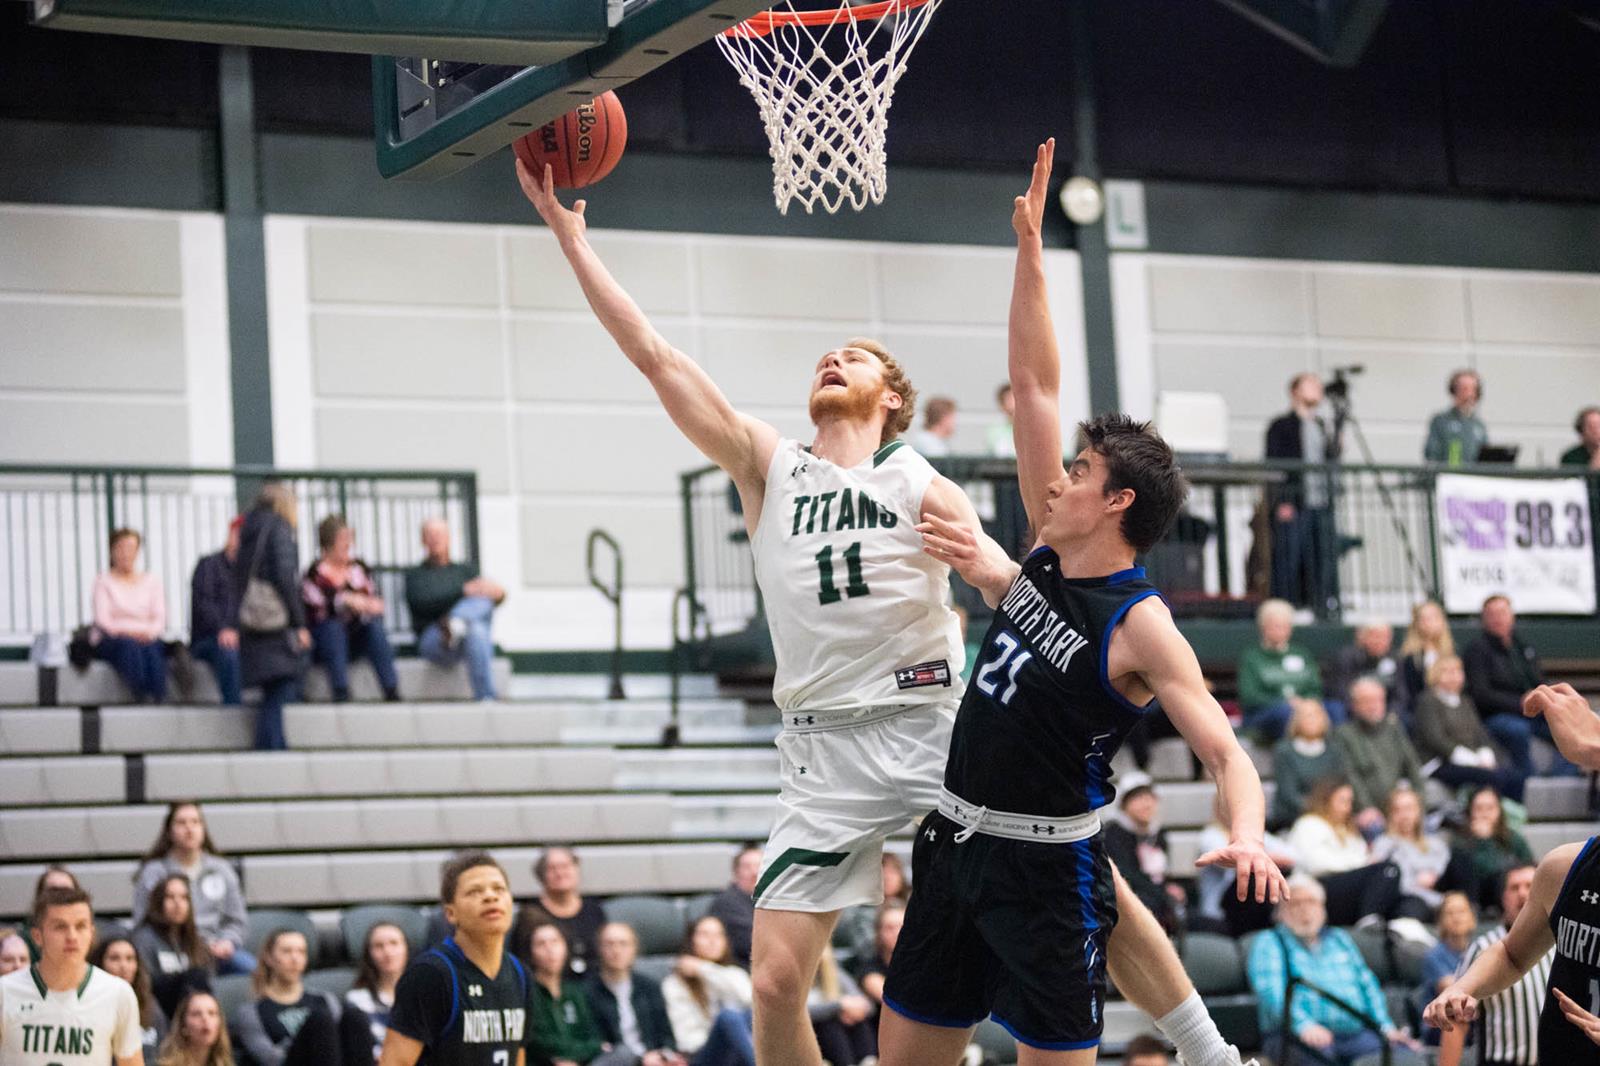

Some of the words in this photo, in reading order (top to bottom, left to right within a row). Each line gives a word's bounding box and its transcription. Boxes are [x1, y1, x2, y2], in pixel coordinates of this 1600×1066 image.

[576, 99, 597, 162] ilson
[791, 487, 898, 536] TITANS
[815, 541, 870, 606] 11
[1000, 569, 1049, 637] NORTH
[1030, 609, 1089, 674] PARK
[975, 631, 1033, 705] 21
[1557, 915, 1600, 968] NORT
[22, 1023, 94, 1056] TITANS
[463, 1009, 503, 1043] NORTH
